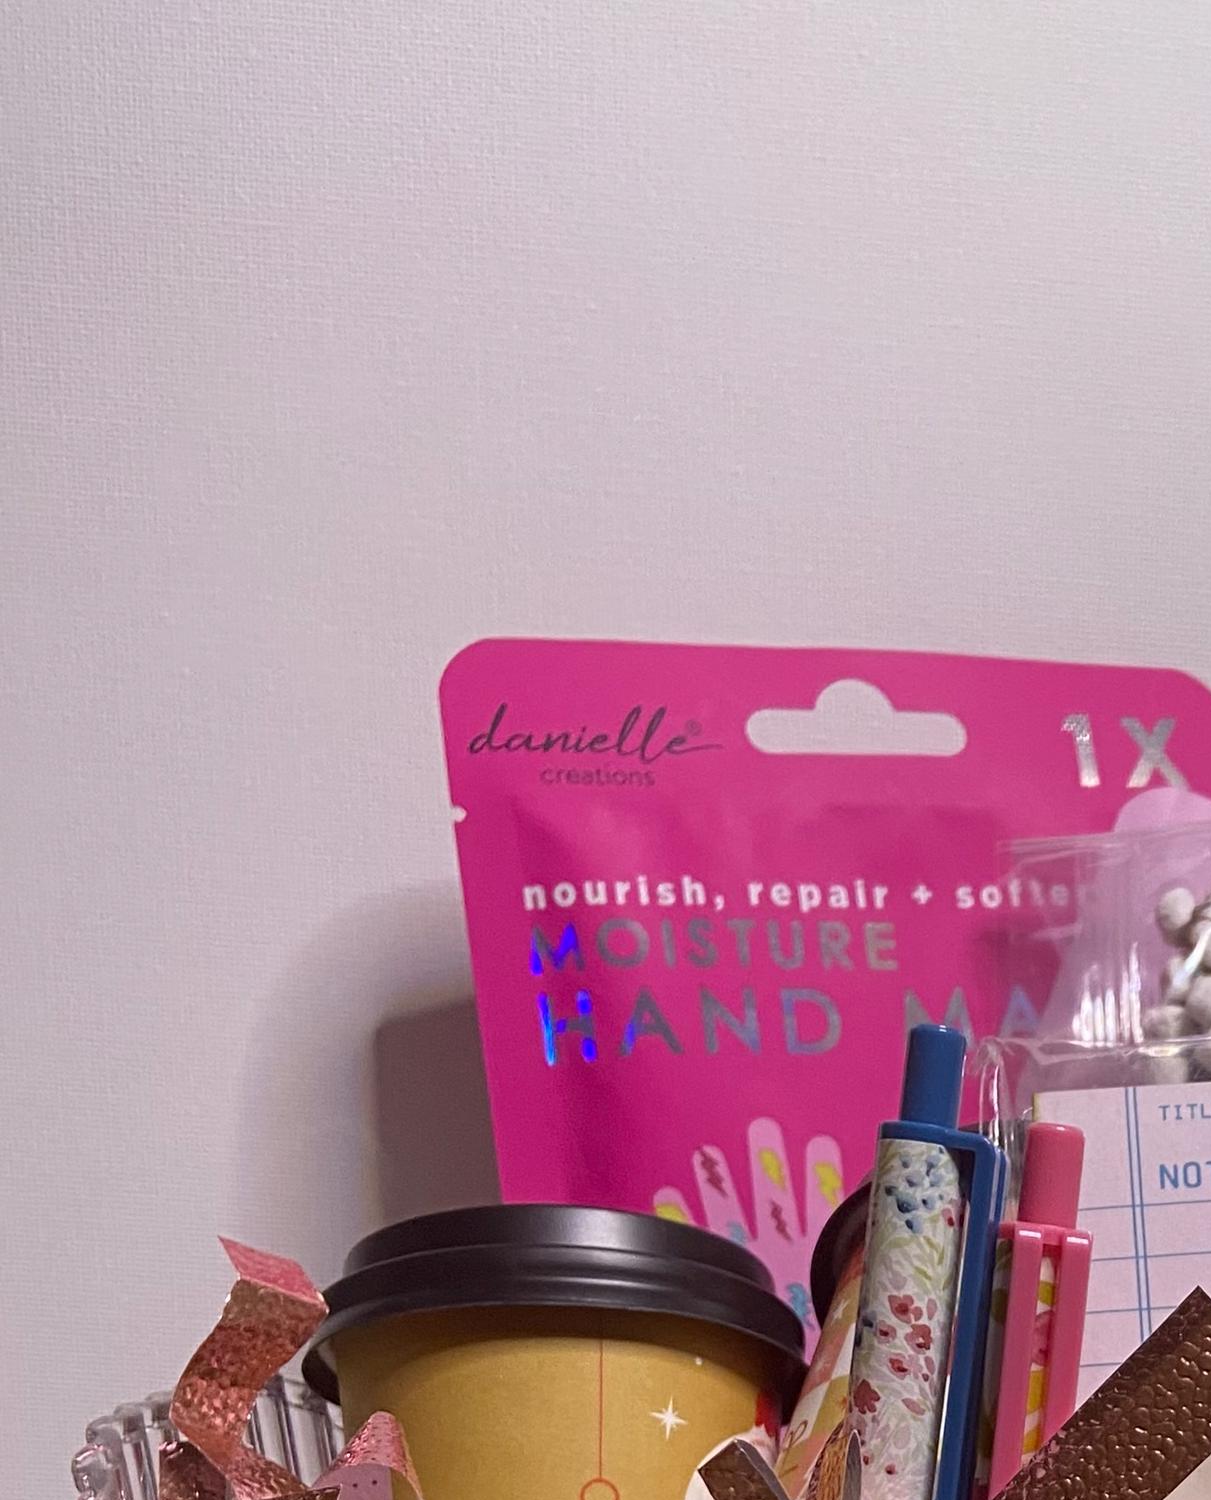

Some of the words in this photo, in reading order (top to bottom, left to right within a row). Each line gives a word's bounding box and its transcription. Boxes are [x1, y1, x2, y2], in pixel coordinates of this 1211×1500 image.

[540, 767, 656, 786] creations
[522, 874, 725, 910] nourish,
[747, 878, 890, 911] repair
[529, 917, 899, 976] MOISTURE
[537, 985, 843, 1066] HAND
